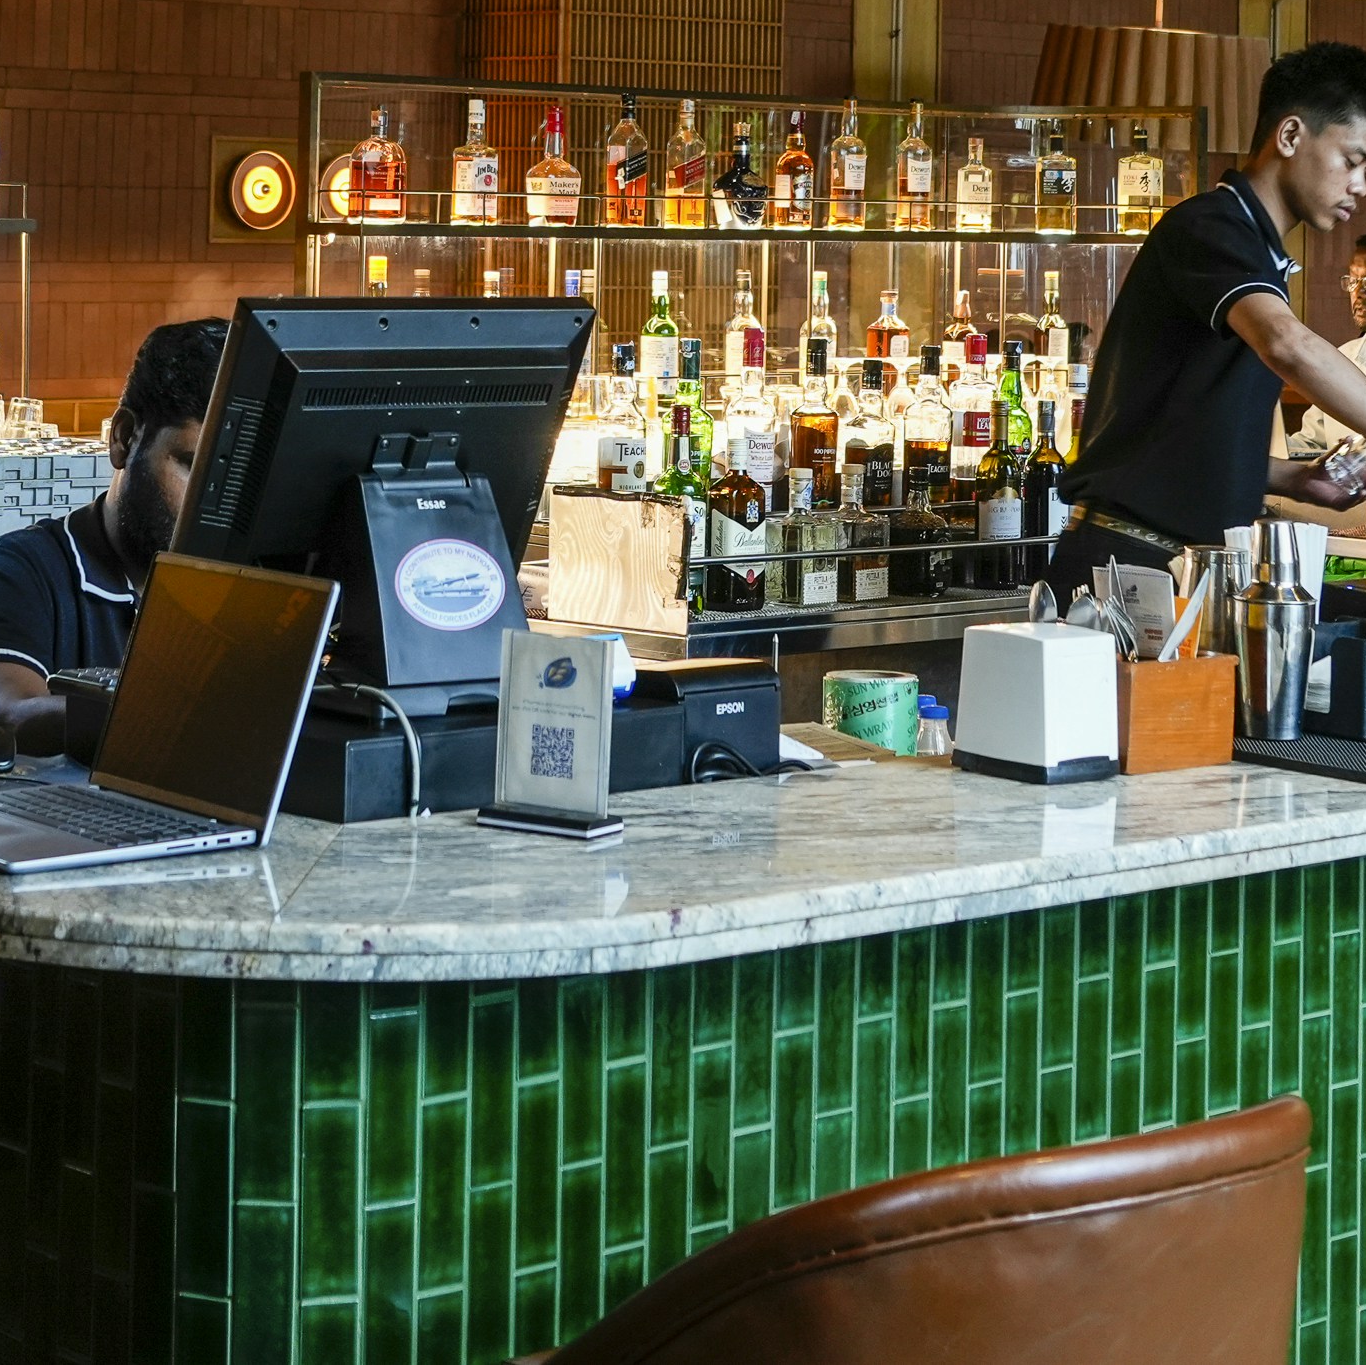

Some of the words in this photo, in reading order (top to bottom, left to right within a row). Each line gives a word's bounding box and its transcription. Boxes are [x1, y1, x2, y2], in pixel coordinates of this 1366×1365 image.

[549, 180, 579, 189] Maker's
[416, 497, 447, 510] Essae
[405, 548, 442, 576] CONTRIBUTE
[443, 547, 454, 555] TO
[455, 547, 465, 555] MY
[466, 550, 492, 572] NATION
[413, 601, 438, 620] ARMED
[438, 613, 469, 624] FORCES
[468, 606, 488, 620] FLAG
[848, 682, 868, 697] SUN
[716, 701, 745, 715] EPSON
